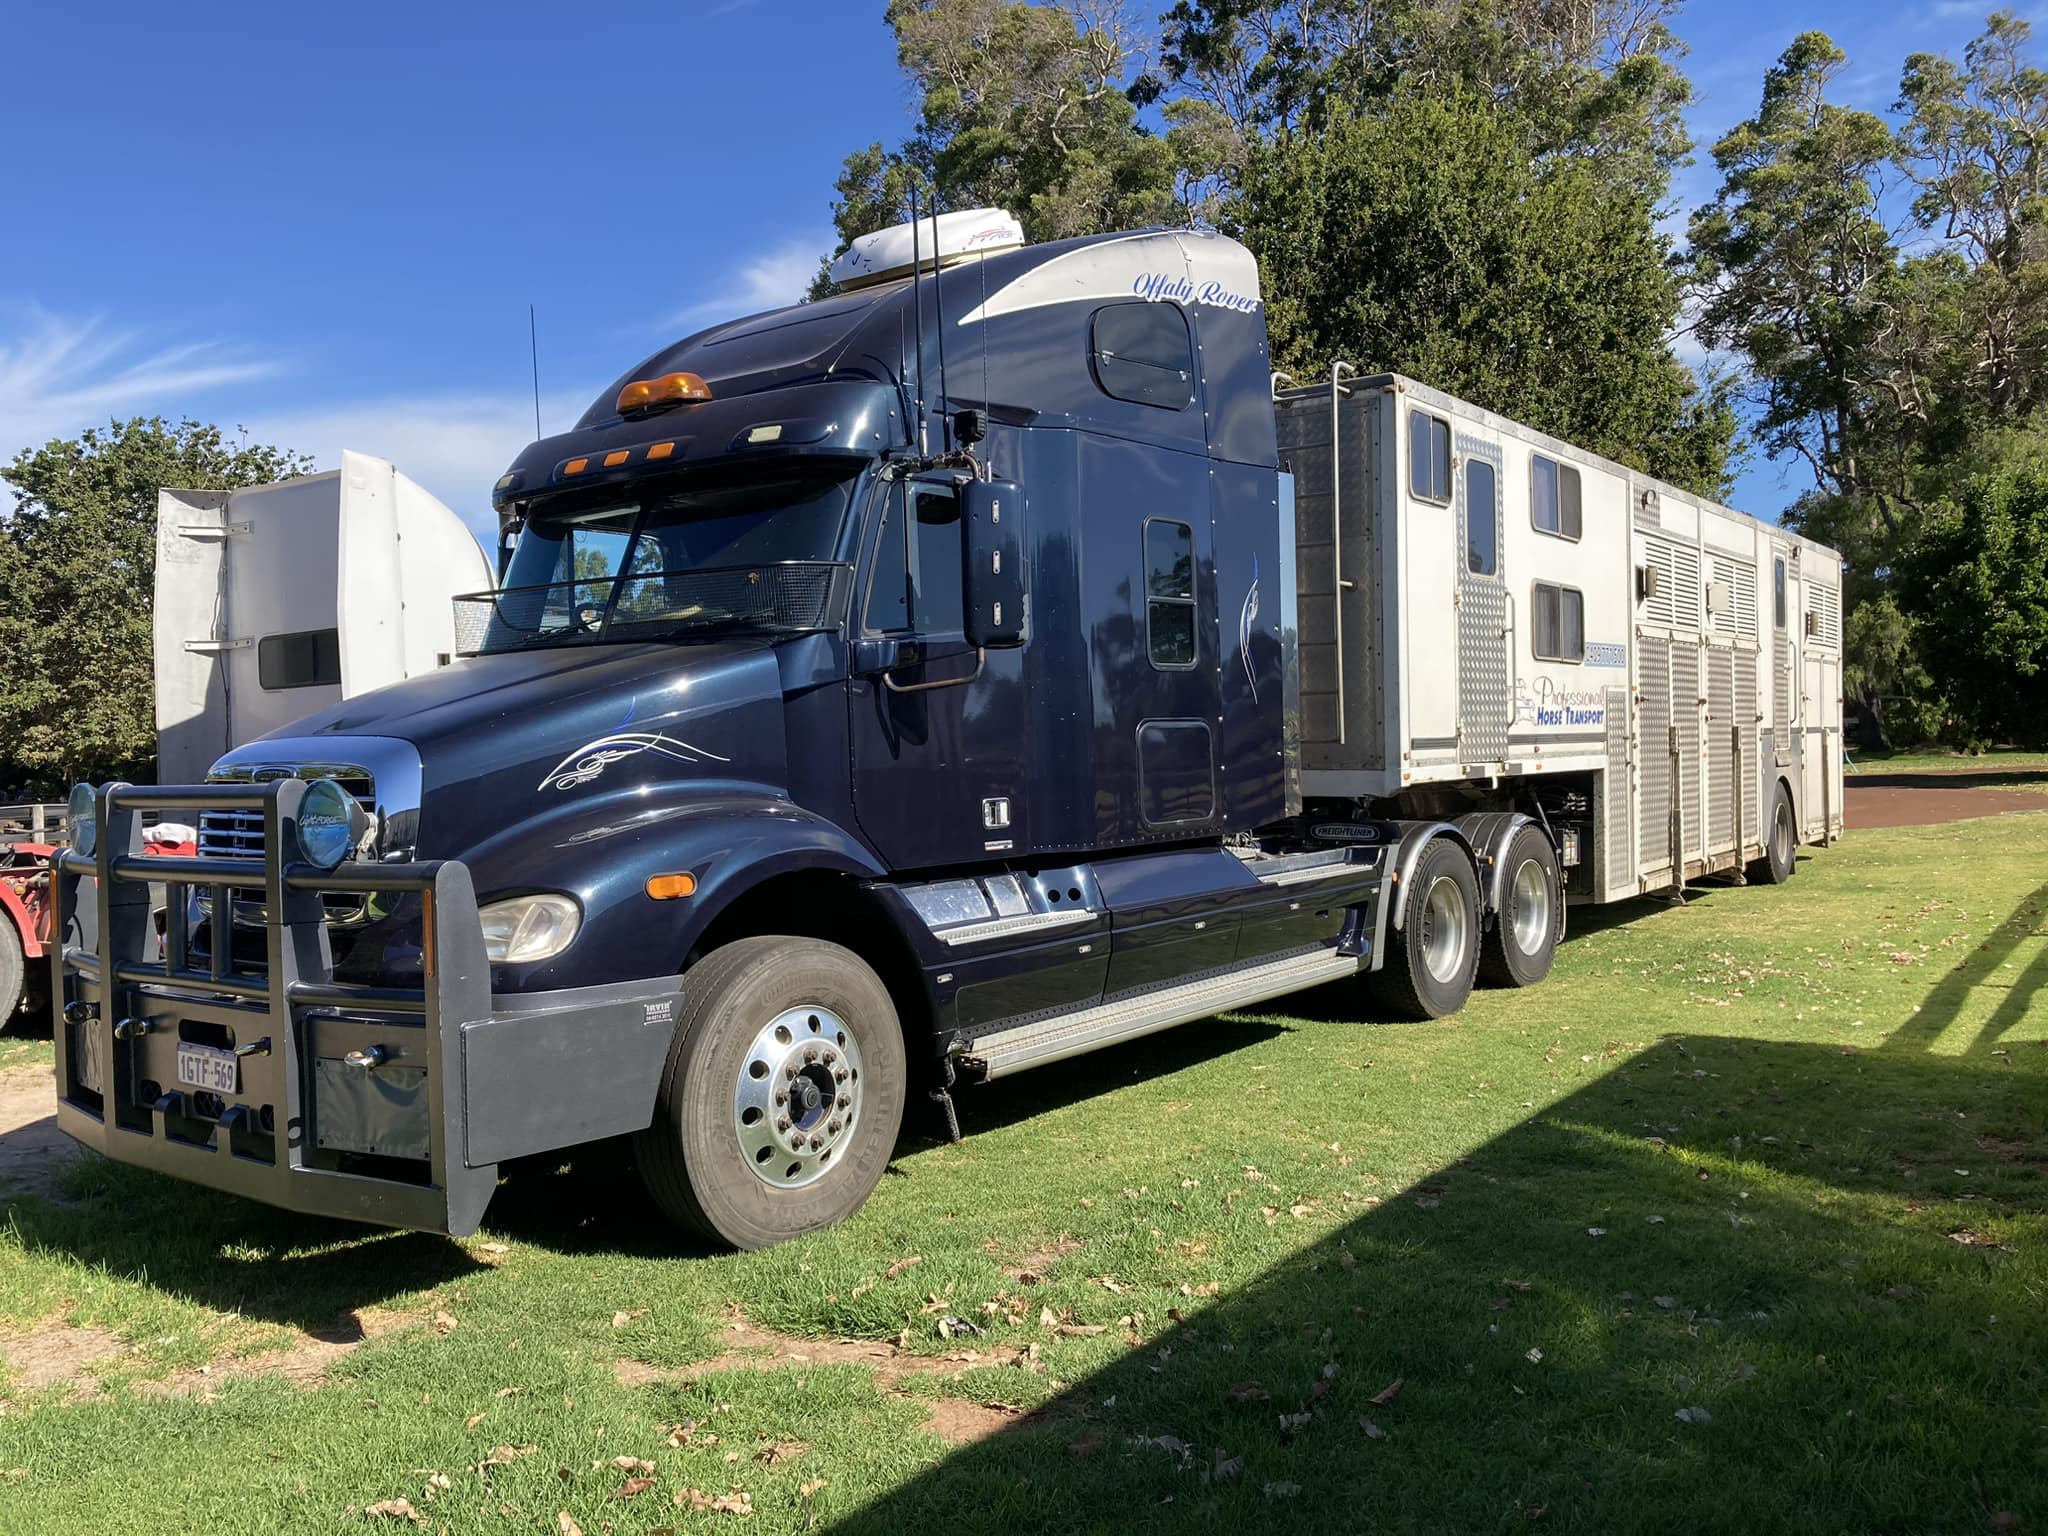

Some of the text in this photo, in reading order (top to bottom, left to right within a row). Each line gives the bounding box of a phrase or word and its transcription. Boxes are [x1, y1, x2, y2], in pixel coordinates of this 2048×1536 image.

[1133, 272, 1194, 304] Offaly
[1533, 675, 1605, 710] Professional
[1317, 826, 1373, 837] FREIGHTLINER
